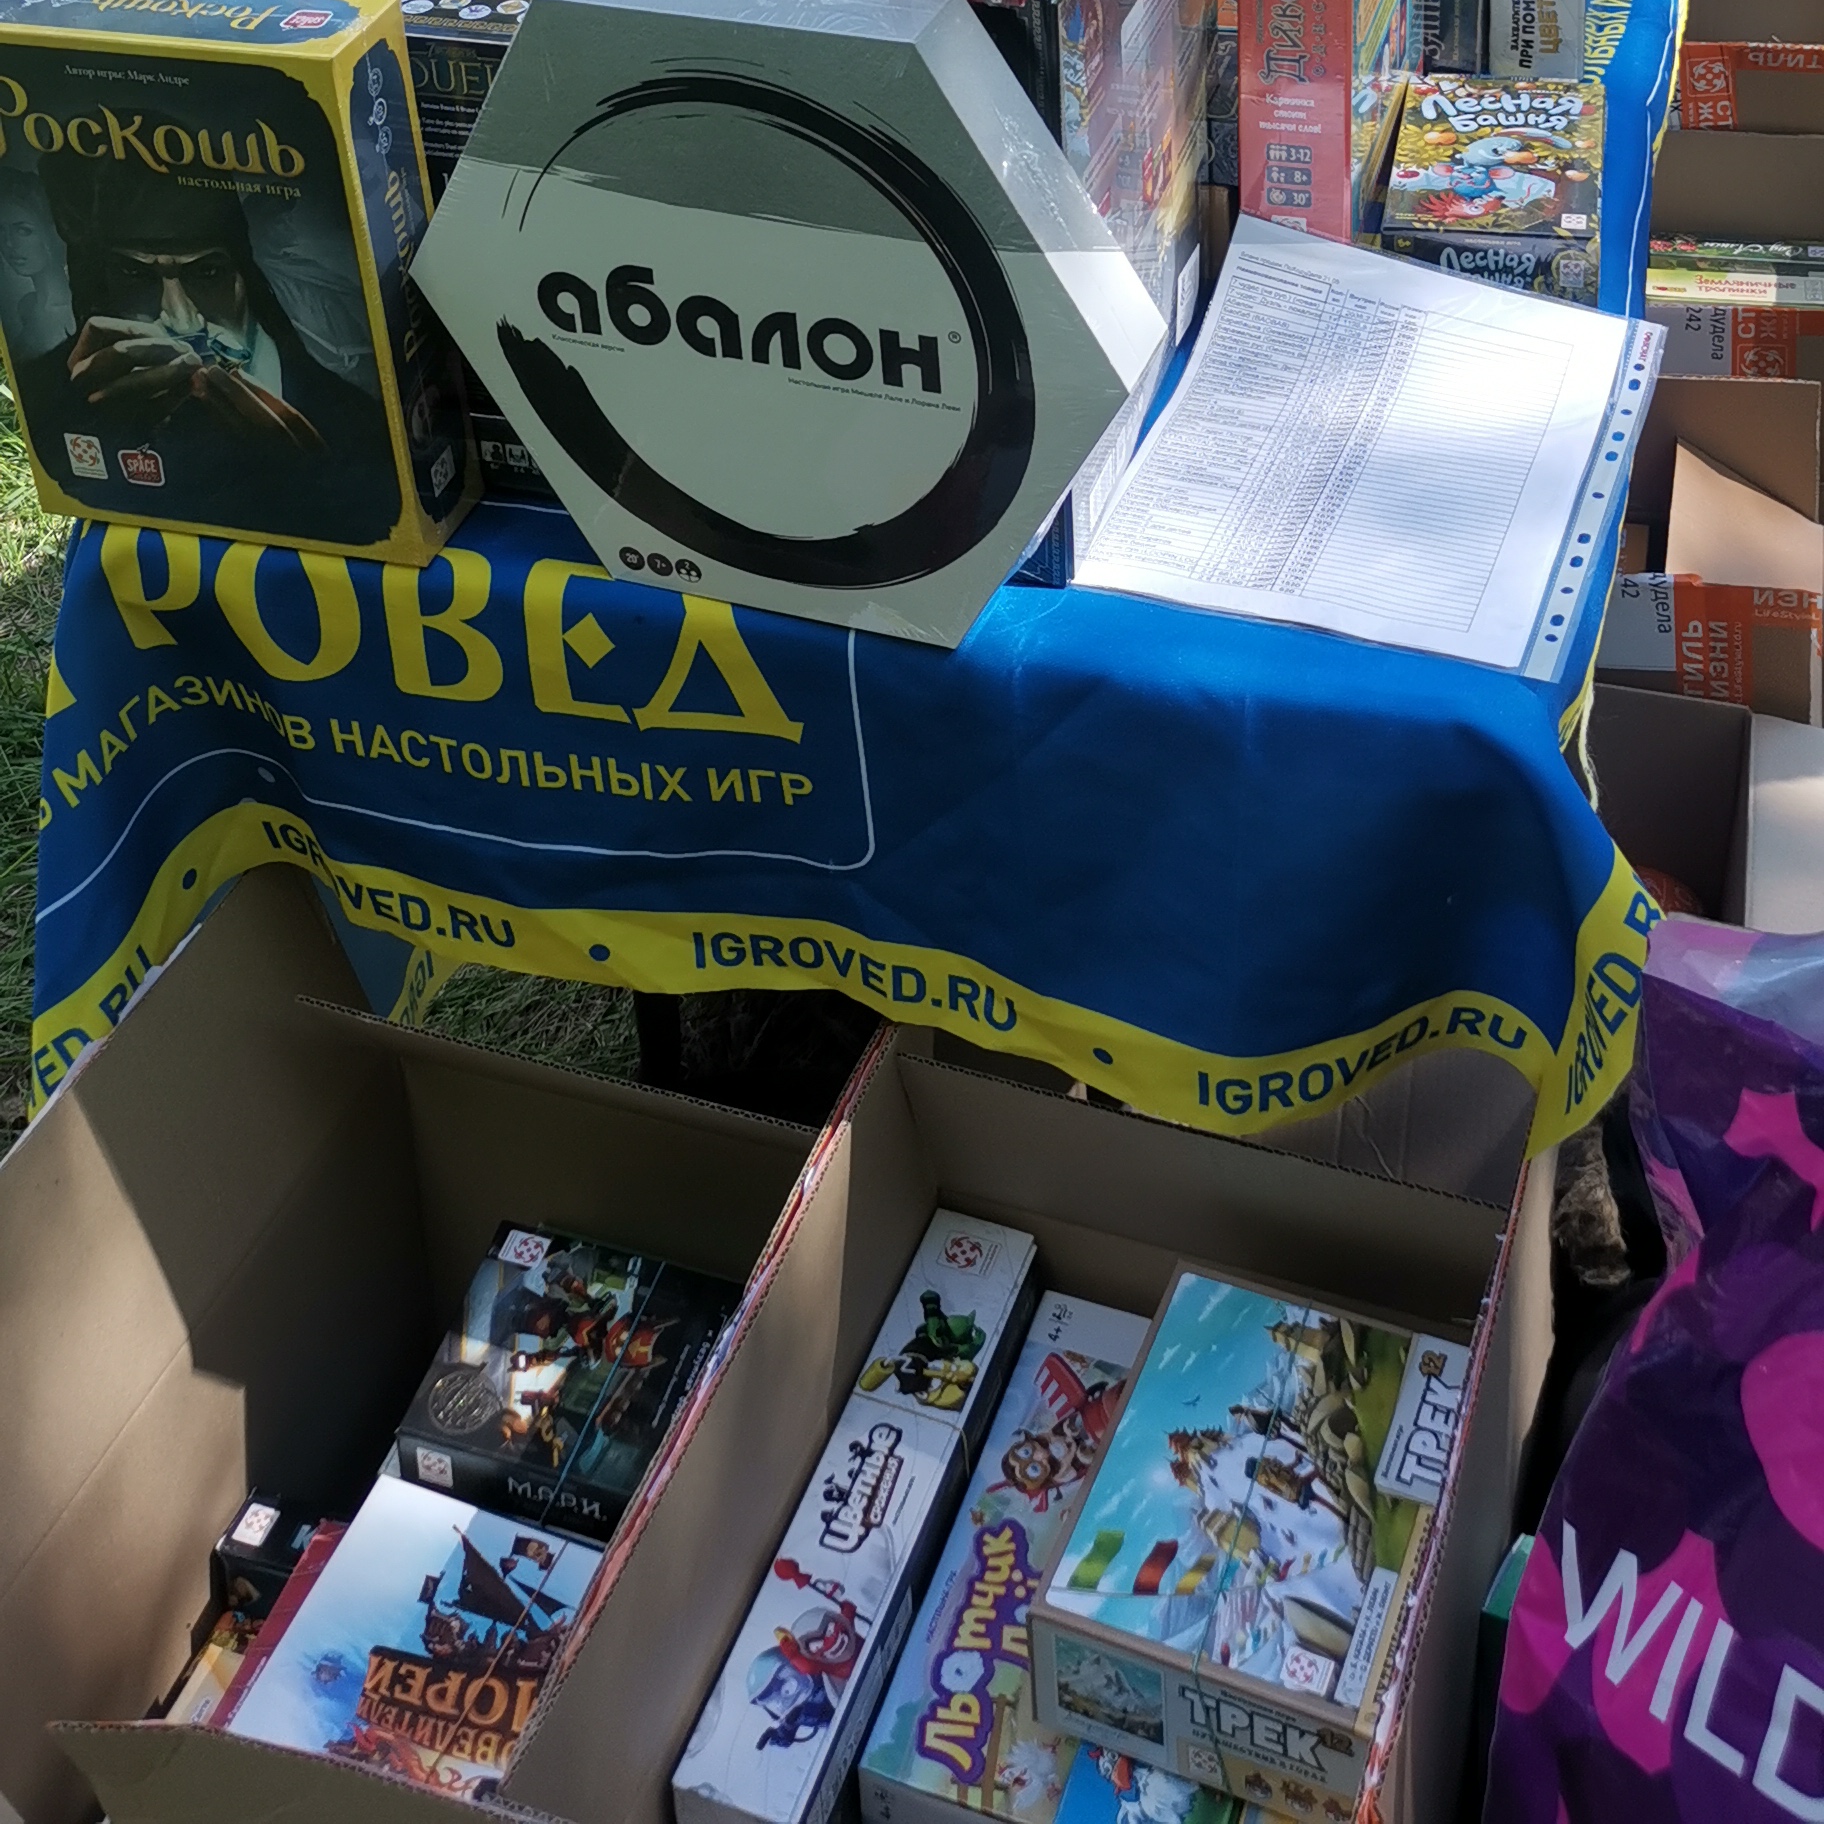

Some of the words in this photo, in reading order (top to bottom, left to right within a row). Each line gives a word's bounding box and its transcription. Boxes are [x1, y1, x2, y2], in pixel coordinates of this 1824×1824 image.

[64, 64, 95, 80] Автор
[126, 69, 156, 85] Марк
[157, 72, 190, 87] Андре
[1519, 39, 1535, 69] ПРИ
[0, 79, 306, 178] Роскошь
[1421, 93, 1584, 120] Лесная
[1448, 111, 1569, 133] Башня
[176, 175, 262, 194] настольная
[266, 184, 301, 200] игра
[1293, 171, 1309, 184] 8+
[1440, 246, 1537, 276] Лесная
[537, 264, 942, 395] абалон
[1620, 576, 1640, 599] 42
[1753, 588, 1823, 610] ИЗН
[101, 521, 805, 745] РОВЕД
[1682, 619, 1704, 698] ТИЛЬ
[1708, 620, 1730, 699] ИЗНИ
[52, 675, 315, 810] МАГАЗИНОВ
[330, 718, 690, 804] НАСТОЛЬНЫХ
[710, 767, 814, 806] ИГР
[692, 929, 1019, 1033] IGROVED.RU
[1198, 1005, 1527, 1116] IGROVED.RU
[1394, 1373, 1463, 1486] ТРЕК
[820, 1422, 903, 1553] Цветные
[355, 1695, 519, 1768] ОВЕЛИТЕЛИ
[1178, 1684, 1328, 1774] ТРЕК
